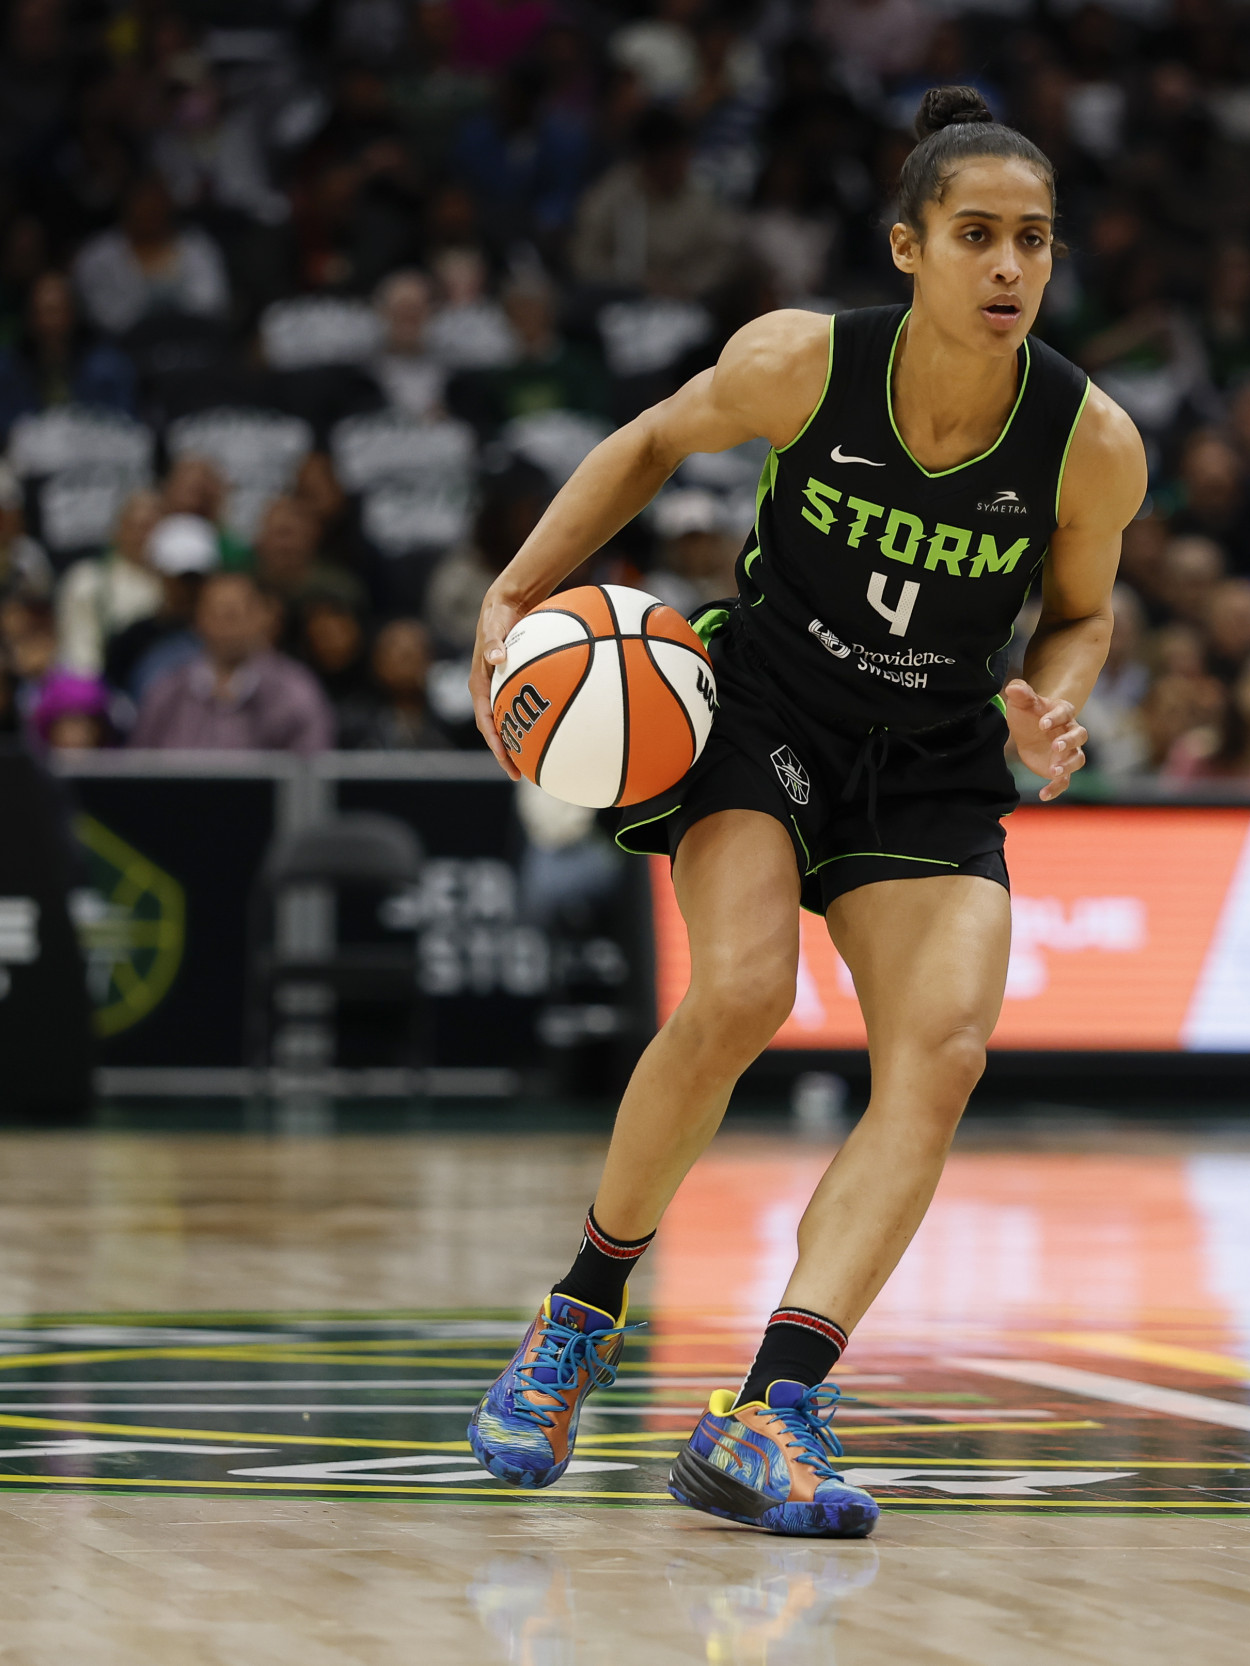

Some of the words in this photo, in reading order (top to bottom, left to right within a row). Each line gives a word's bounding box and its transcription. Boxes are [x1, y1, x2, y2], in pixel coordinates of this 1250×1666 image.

[976, 502, 1027, 514] SYMETRA
[801, 477, 1030, 578] STORM
[866, 571, 921, 637] 4
[852, 643, 956, 666] Providence
[857, 657, 928, 688] SWEDISH
